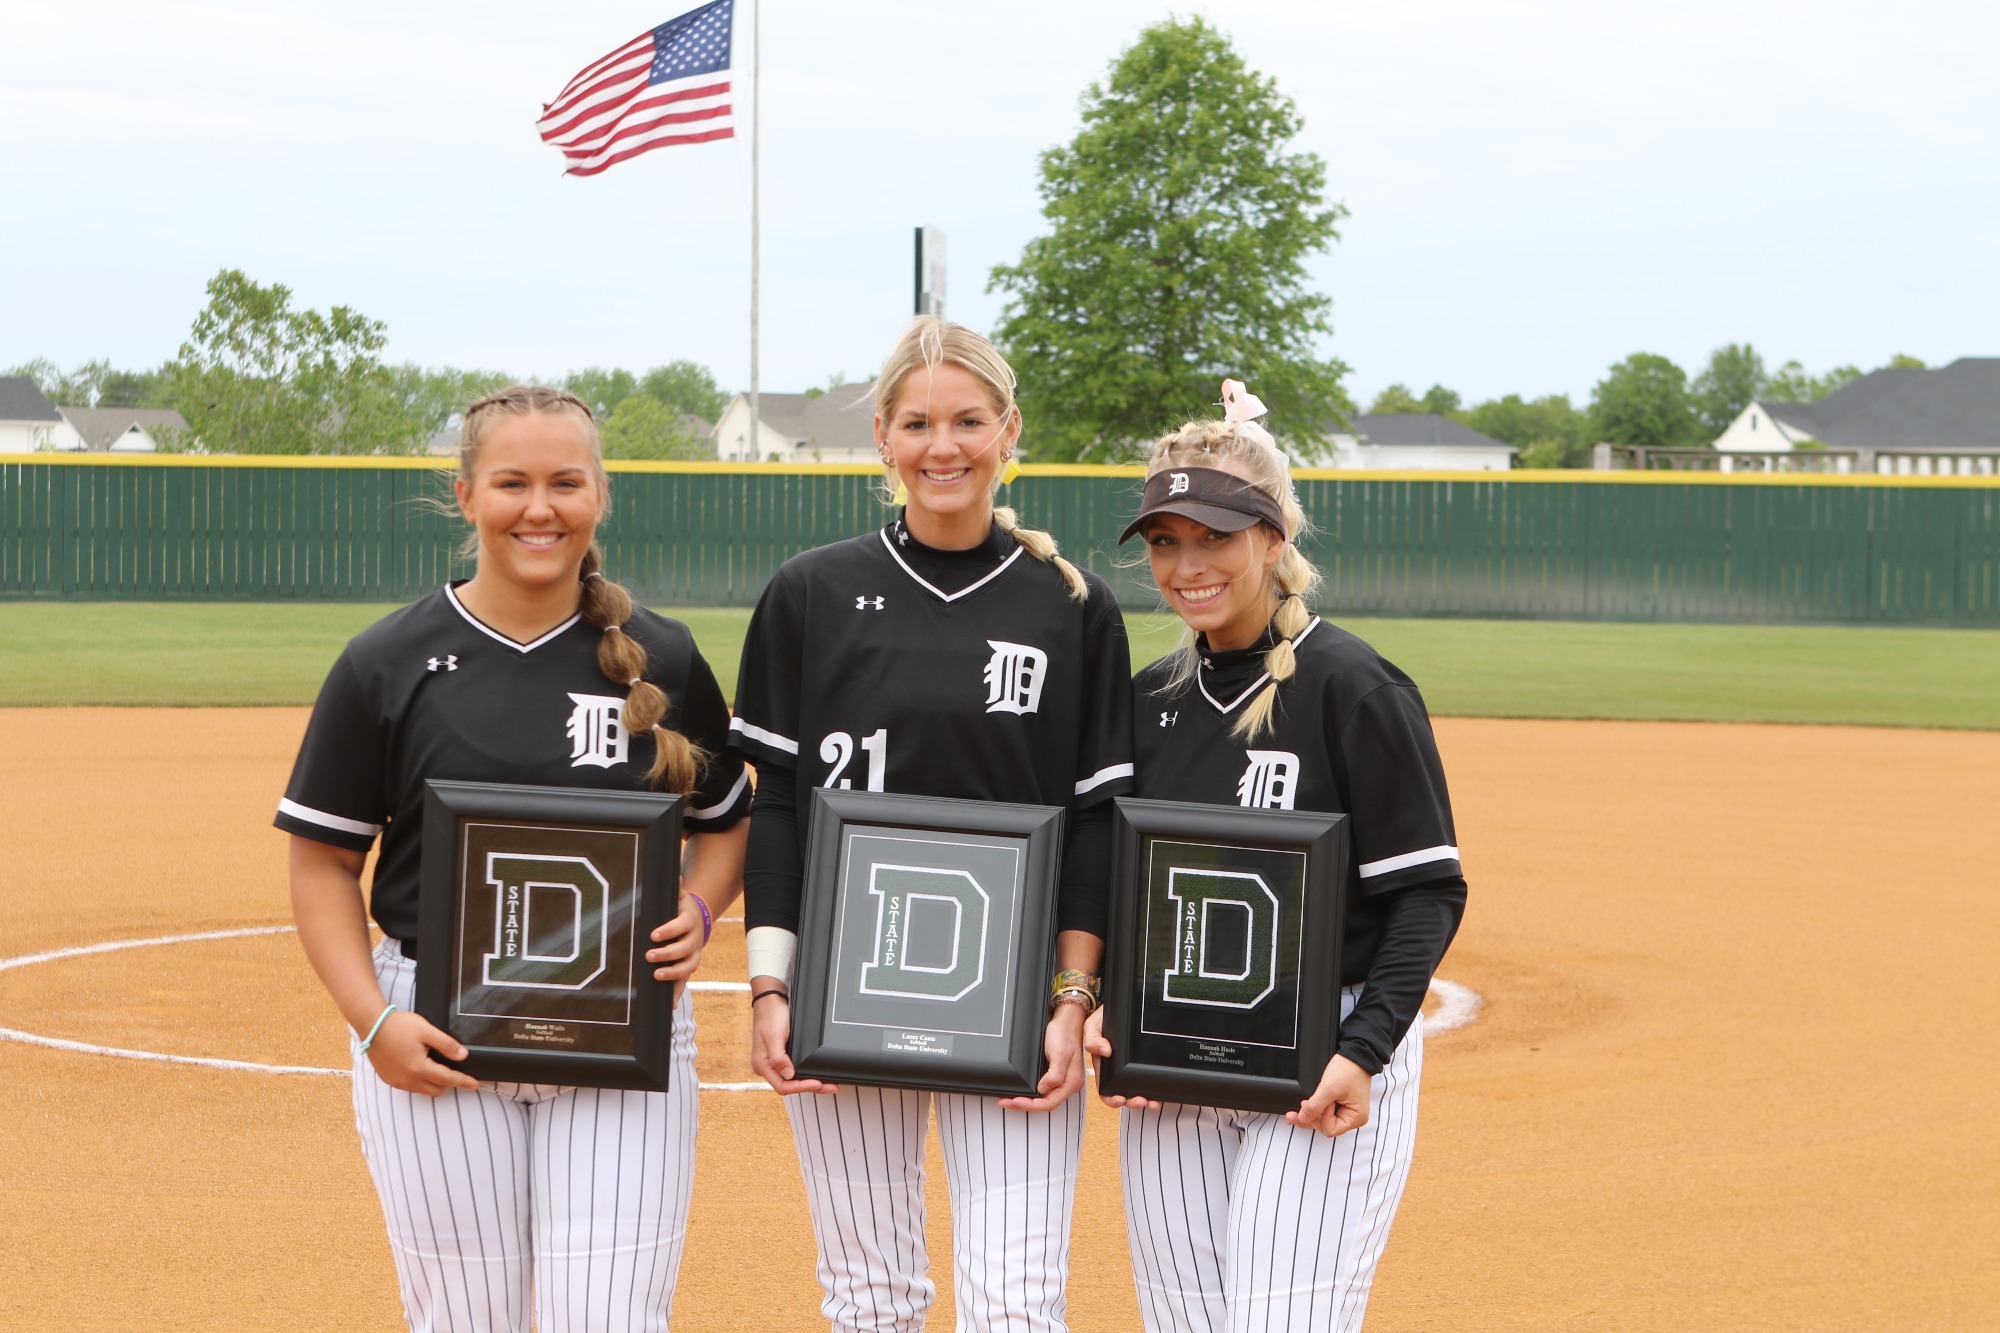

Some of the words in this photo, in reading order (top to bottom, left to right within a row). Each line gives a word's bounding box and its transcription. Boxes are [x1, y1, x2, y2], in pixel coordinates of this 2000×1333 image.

[1168, 473, 1190, 496] D
[983, 639, 1048, 716] D
[566, 692, 630, 769] D
[820, 728, 887, 793] 21
[1236, 750, 1300, 810] D
[482, 852, 609, 990] D
[505, 885, 519, 957] STATE
[859, 863, 990, 1001] D
[884, 896, 900, 966] STATE
[1163, 867, 1279, 1009] D
[1184, 901, 1197, 973] STATE
[545, 1036, 575, 1044] University
[919, 1046, 949, 1055] University
[1217, 1057, 1244, 1067] University
